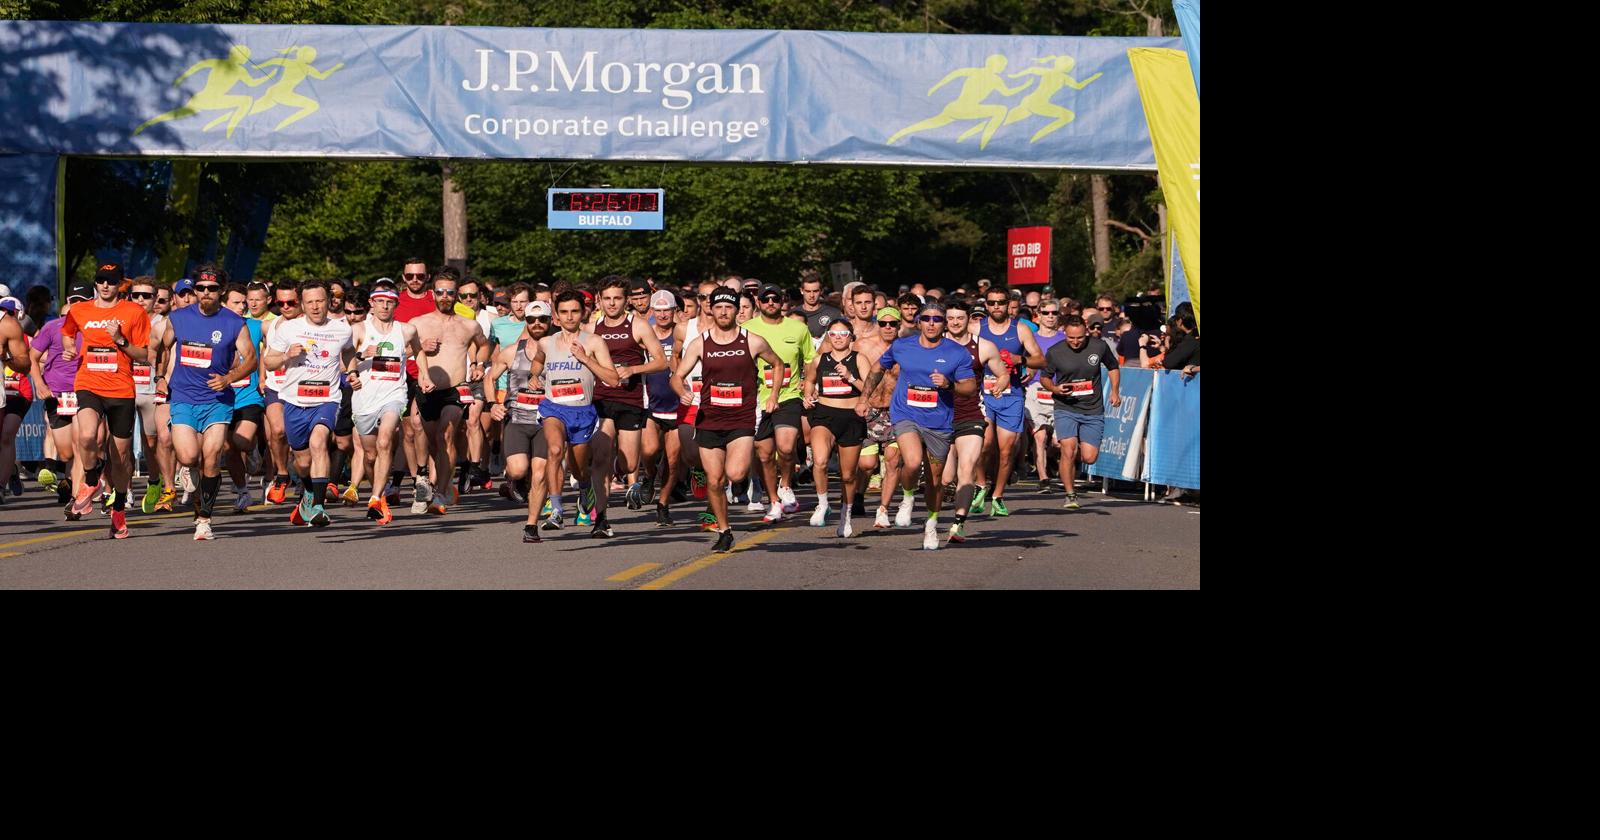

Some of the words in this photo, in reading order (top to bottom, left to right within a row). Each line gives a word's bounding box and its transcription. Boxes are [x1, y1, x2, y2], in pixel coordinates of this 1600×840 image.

[464, 114, 609, 140] Corporate
[578, 215, 632, 226] BUFFALO
[1012, 243, 1026, 256] RED
[1027, 242, 1041, 255] BIB
[1013, 256, 1037, 269] ENTRY
[186, 350, 205, 358] 1151
[707, 350, 745, 358] MOOG
